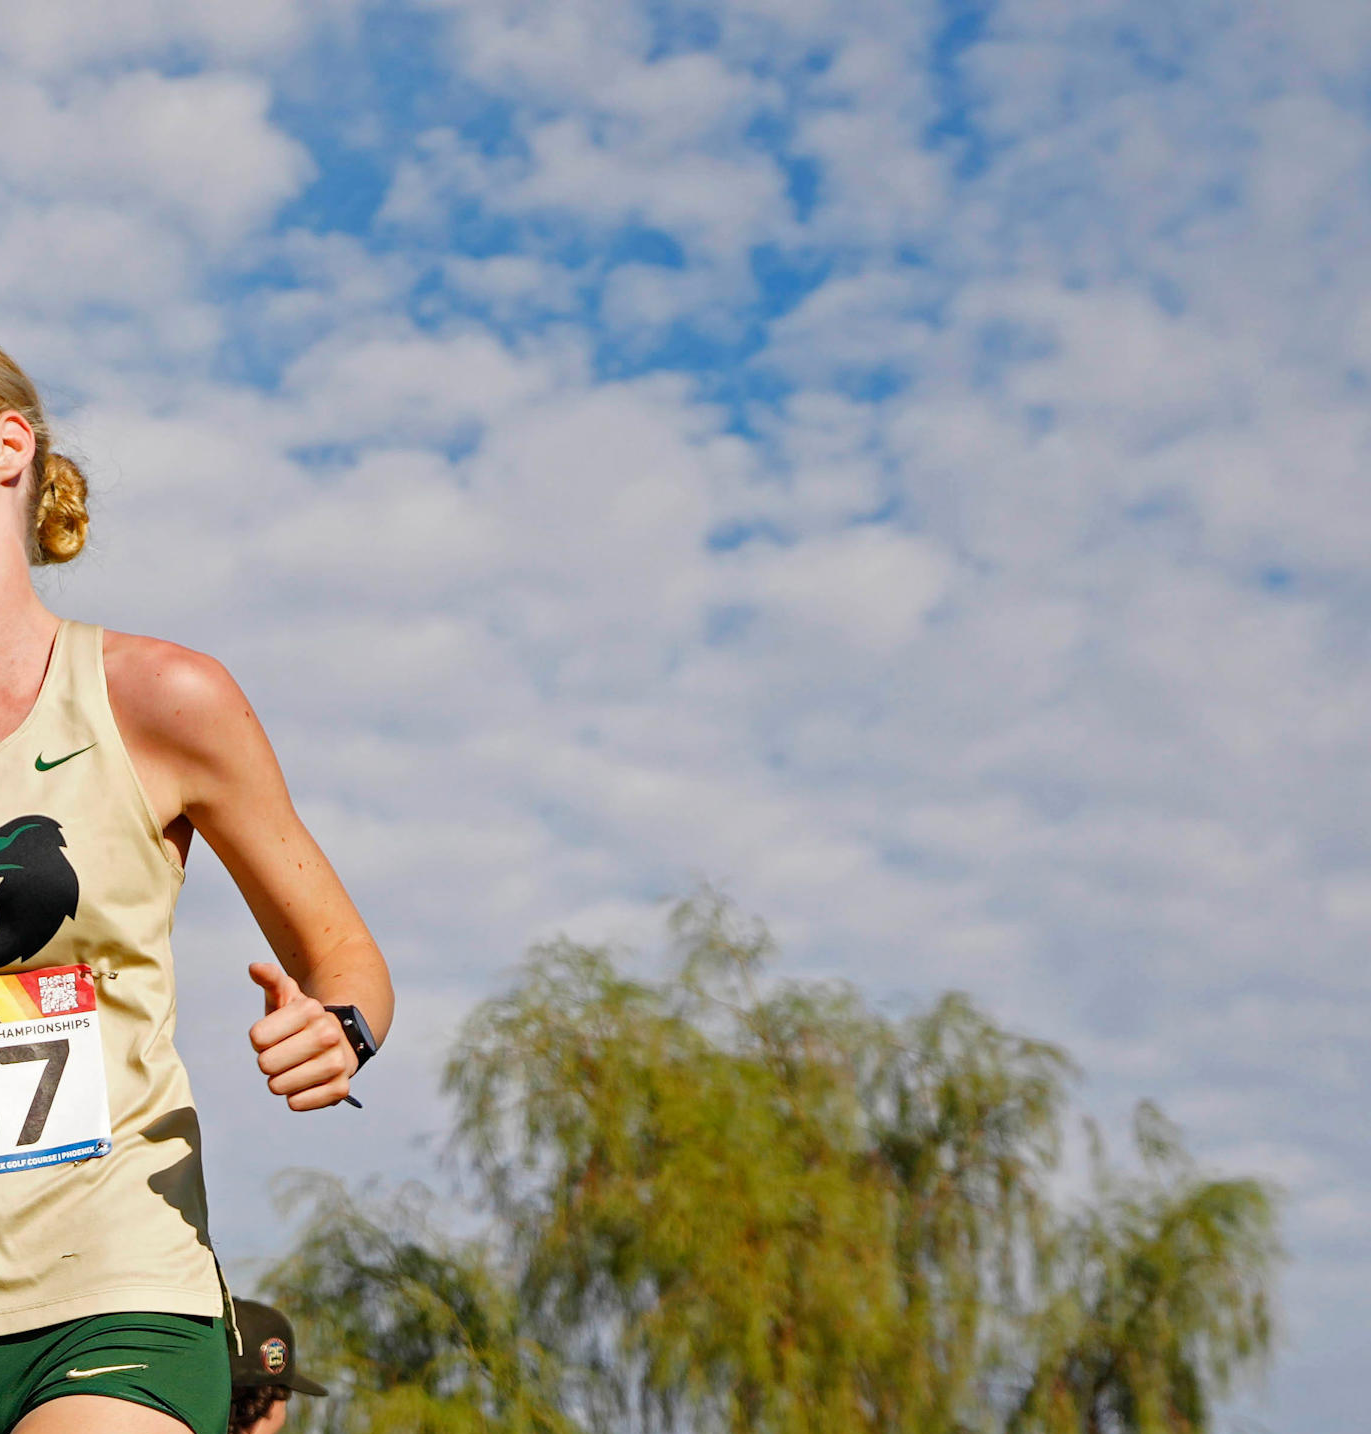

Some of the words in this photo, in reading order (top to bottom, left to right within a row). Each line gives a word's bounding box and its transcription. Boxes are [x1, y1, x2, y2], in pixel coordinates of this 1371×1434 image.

[6, 1159, 27, 1170] GOLF
[27, 1153, 58, 1166] COURSE
[62, 1145, 95, 1160] PHOENIX
